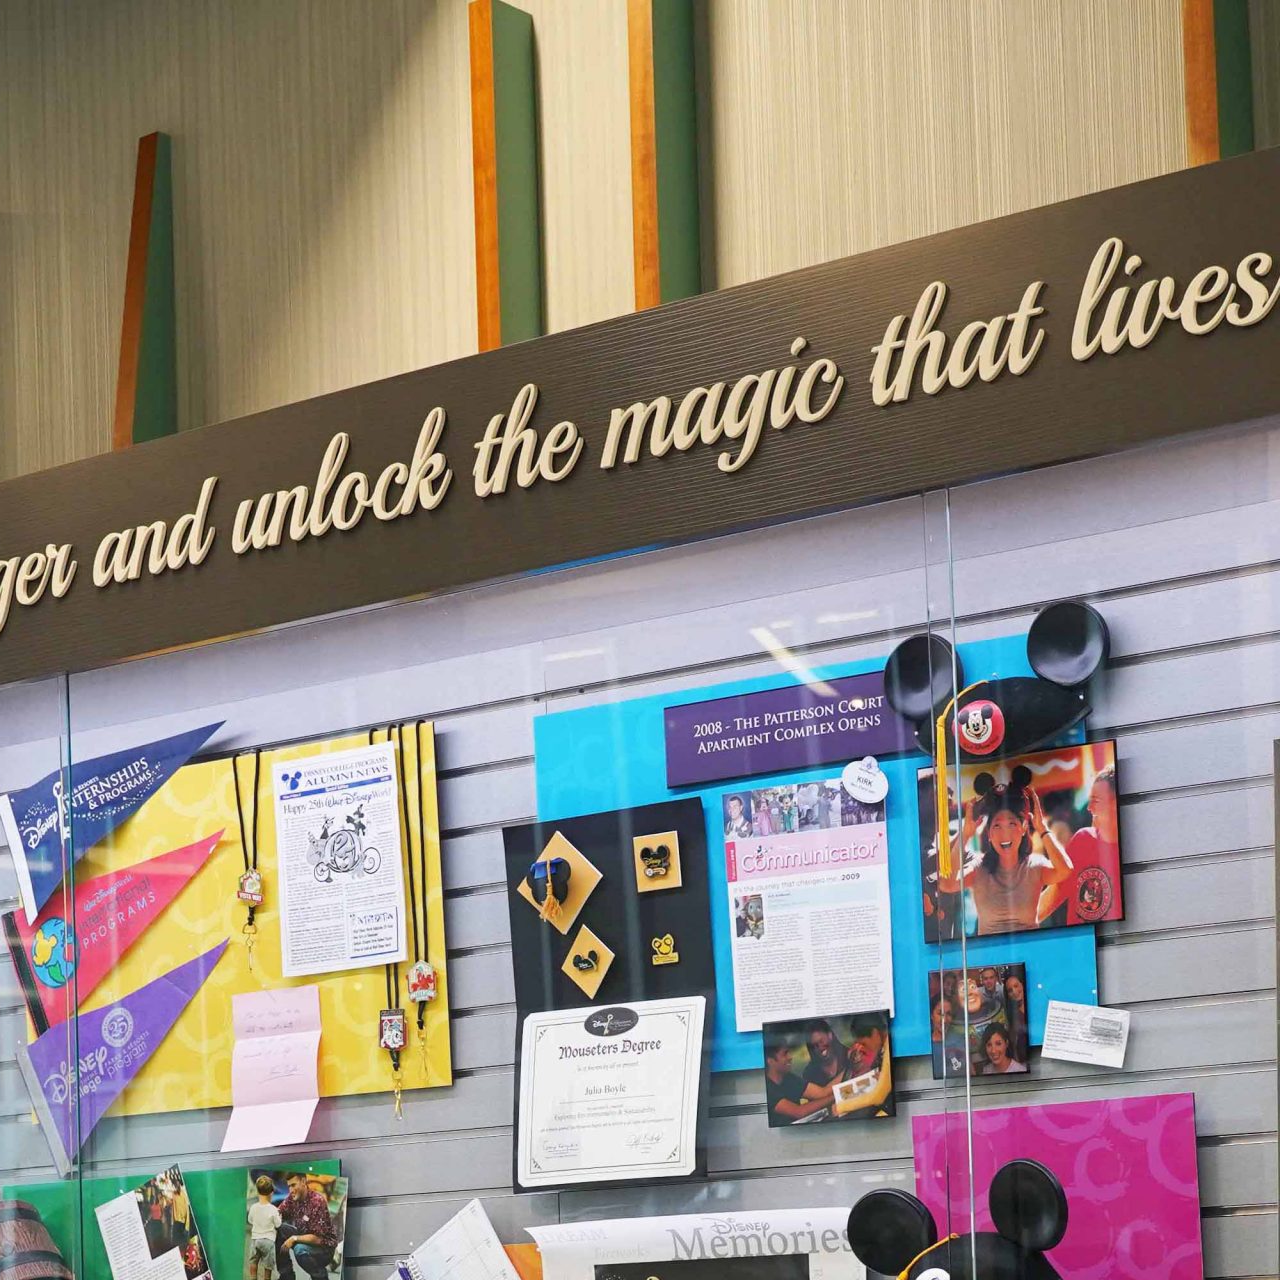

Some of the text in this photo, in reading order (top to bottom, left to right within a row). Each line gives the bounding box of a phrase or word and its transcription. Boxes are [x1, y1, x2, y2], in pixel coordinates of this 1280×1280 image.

[93, 477, 217, 587] and
[231, 407, 452, 554] unlock
[473, 384, 583, 498] the
[600, 337, 844, 472] magic
[870, 280, 1045, 406] that
[1072, 237, 1280, 361] lives
[693, 695, 884, 738] 2008 THE PATTERSON COURT
[697, 714, 881, 754] APARTMENT COMPLEX OPENS
[88, 769, 152, 810] & PROGRAMS
[305, 764, 389, 787] ALUMNI NEWS
[283, 802, 306, 815] Happy
[742, 842, 878, 873] Communicator
[841, 873, 861, 881] 2009
[83, 891, 156, 949] PROGRAMS
[108, 1016, 128, 1040] 25
[106, 1041, 148, 1080] program
[558, 1038, 661, 1060] Mouseters Degree
[584, 1083, 627, 1096] Julia Boyle
[666, 1221, 854, 1261] Memories
